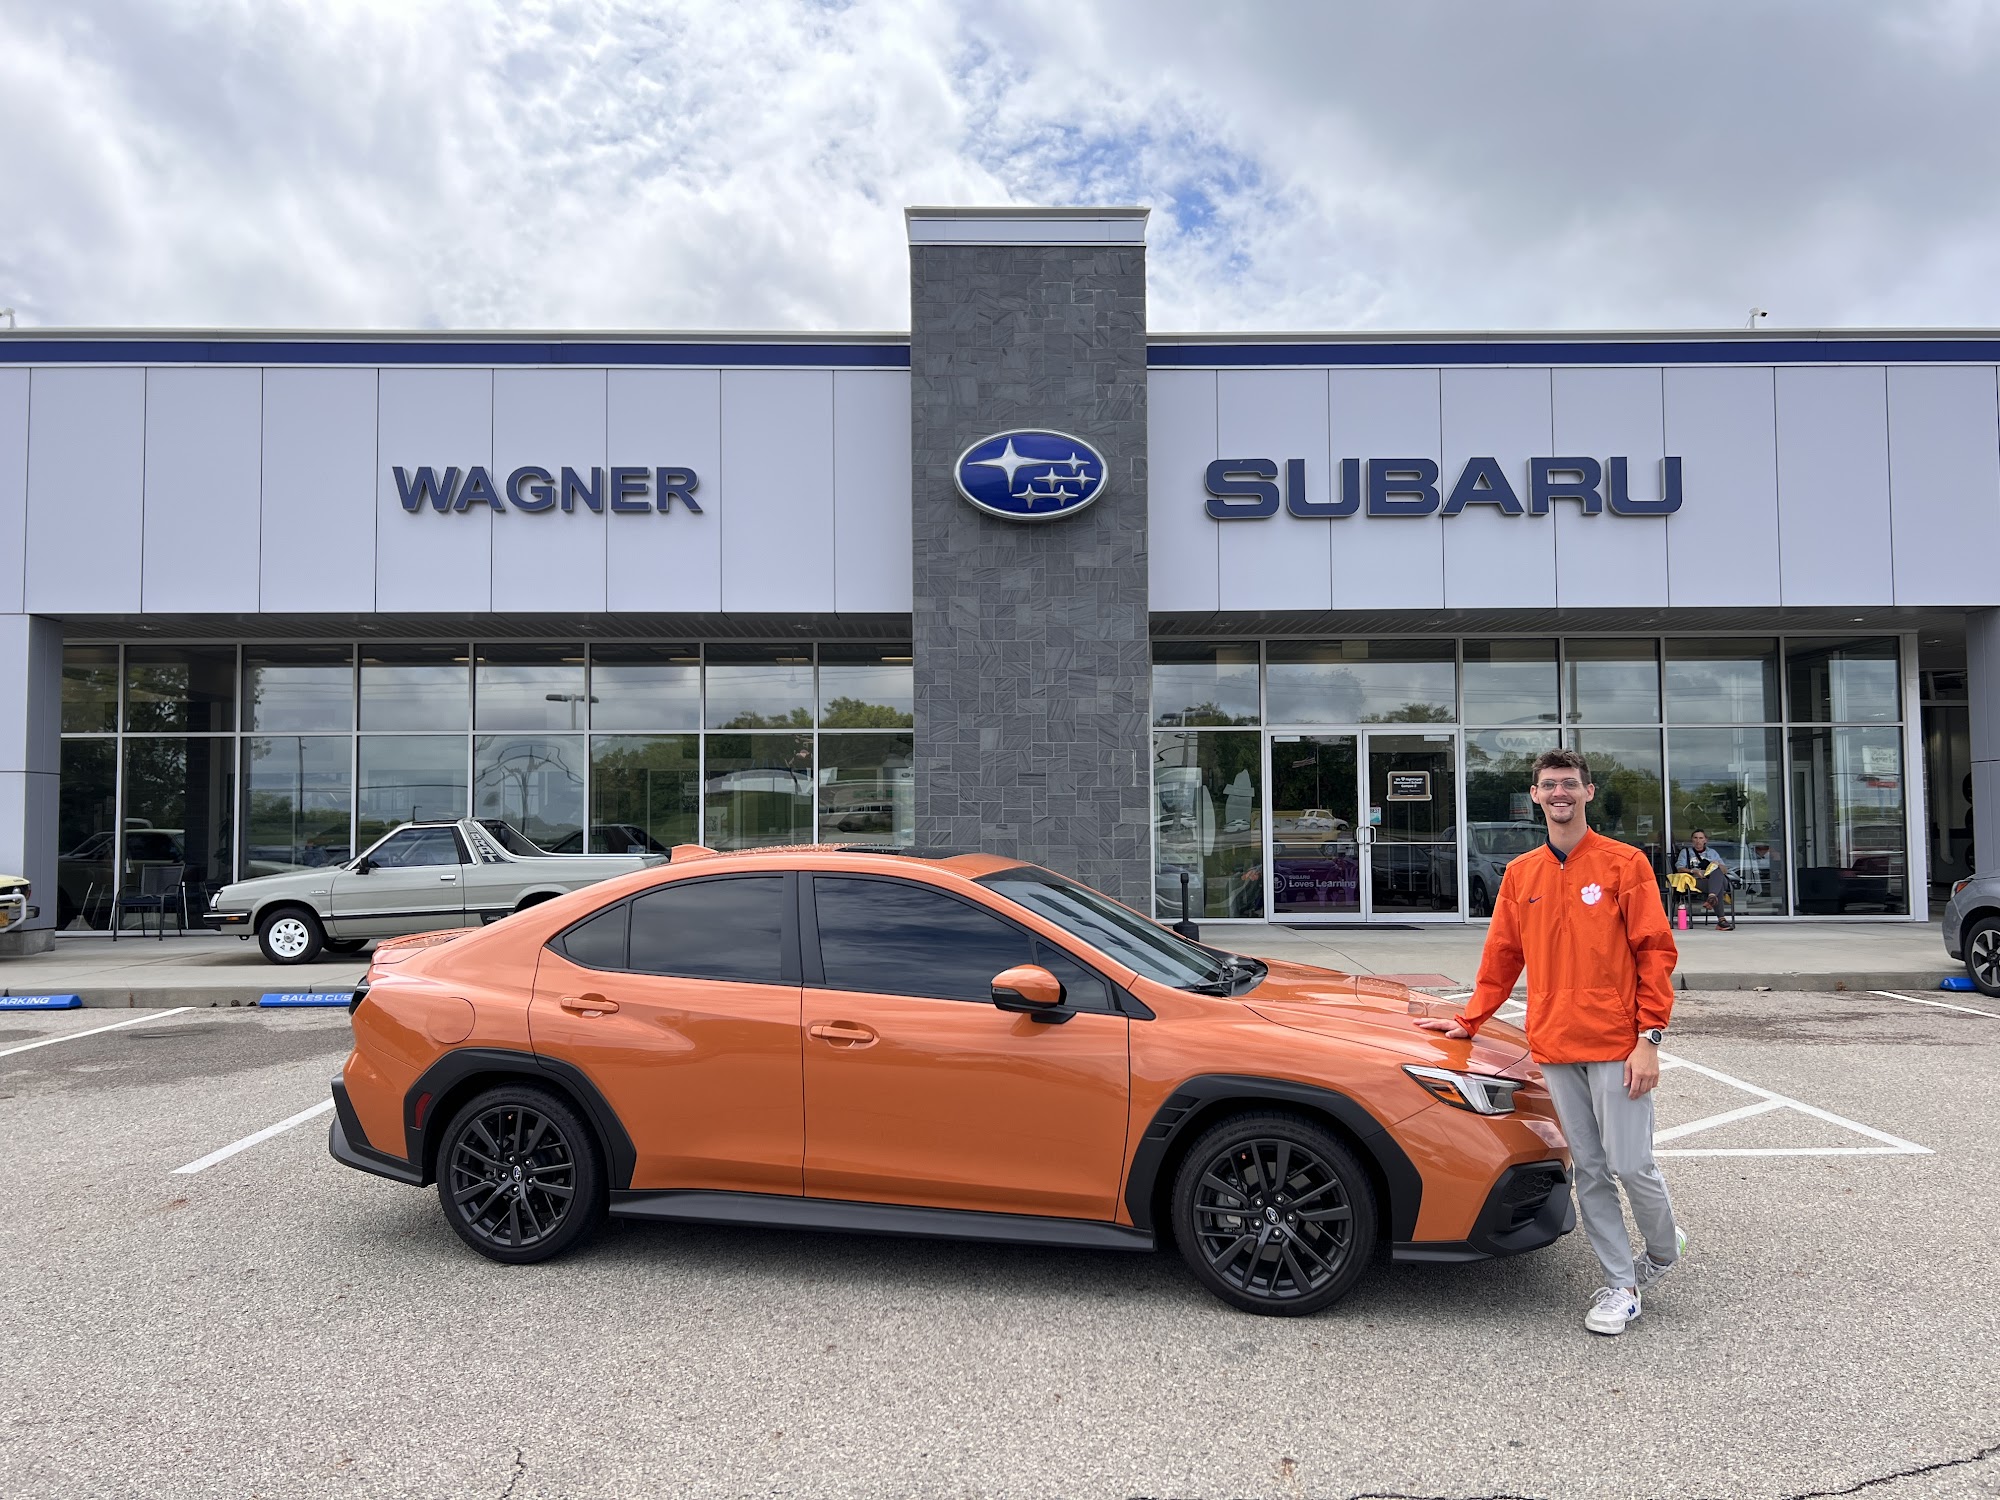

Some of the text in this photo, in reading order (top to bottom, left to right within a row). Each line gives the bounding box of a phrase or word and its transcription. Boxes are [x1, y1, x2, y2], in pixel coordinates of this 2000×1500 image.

[392, 465, 703, 513] WAGNER
[1204, 456, 1683, 519] SUBARU
[470, 833, 497, 863] BRAT
[1289, 879, 1356, 889] Loves Learning
[280, 994, 323, 1002] SALES
